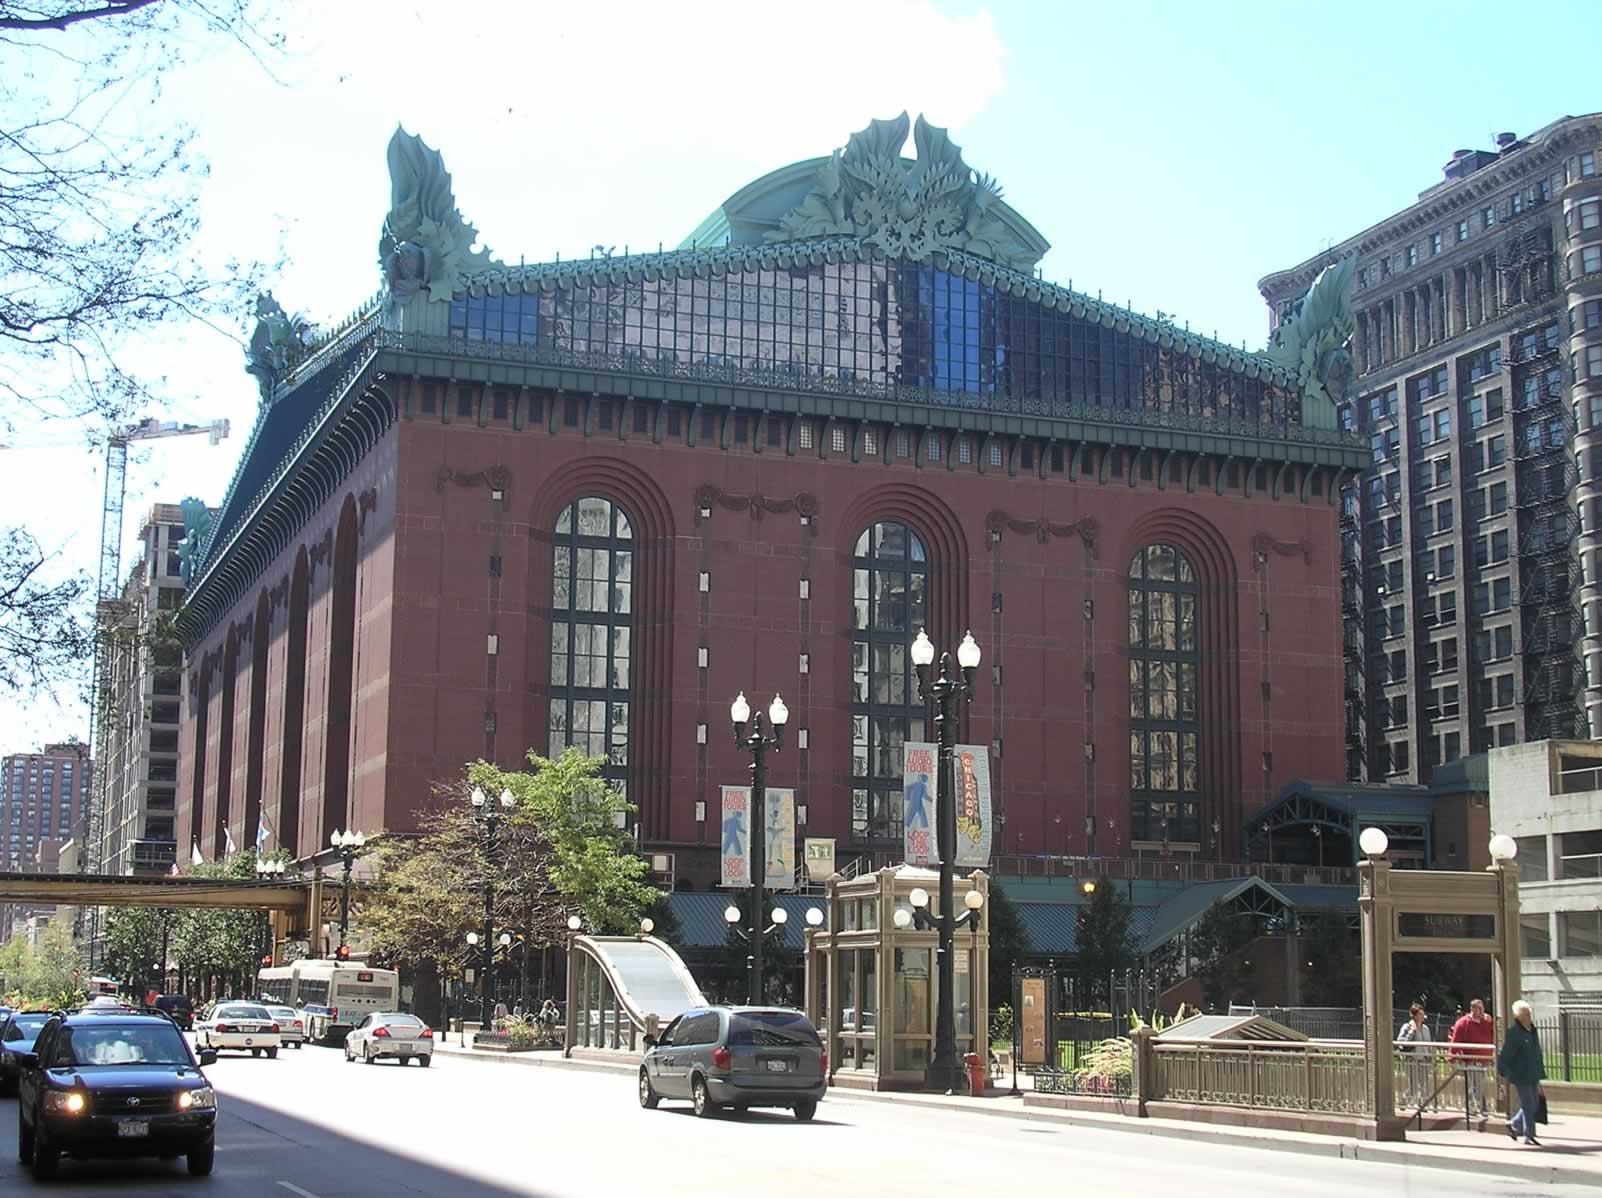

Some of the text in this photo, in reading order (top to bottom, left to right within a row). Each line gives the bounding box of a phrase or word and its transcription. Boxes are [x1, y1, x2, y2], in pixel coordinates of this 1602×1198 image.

[965, 759, 973, 816] CHICAGO
[907, 831, 929, 839] LOOP
[907, 846, 929, 854] LOOP
